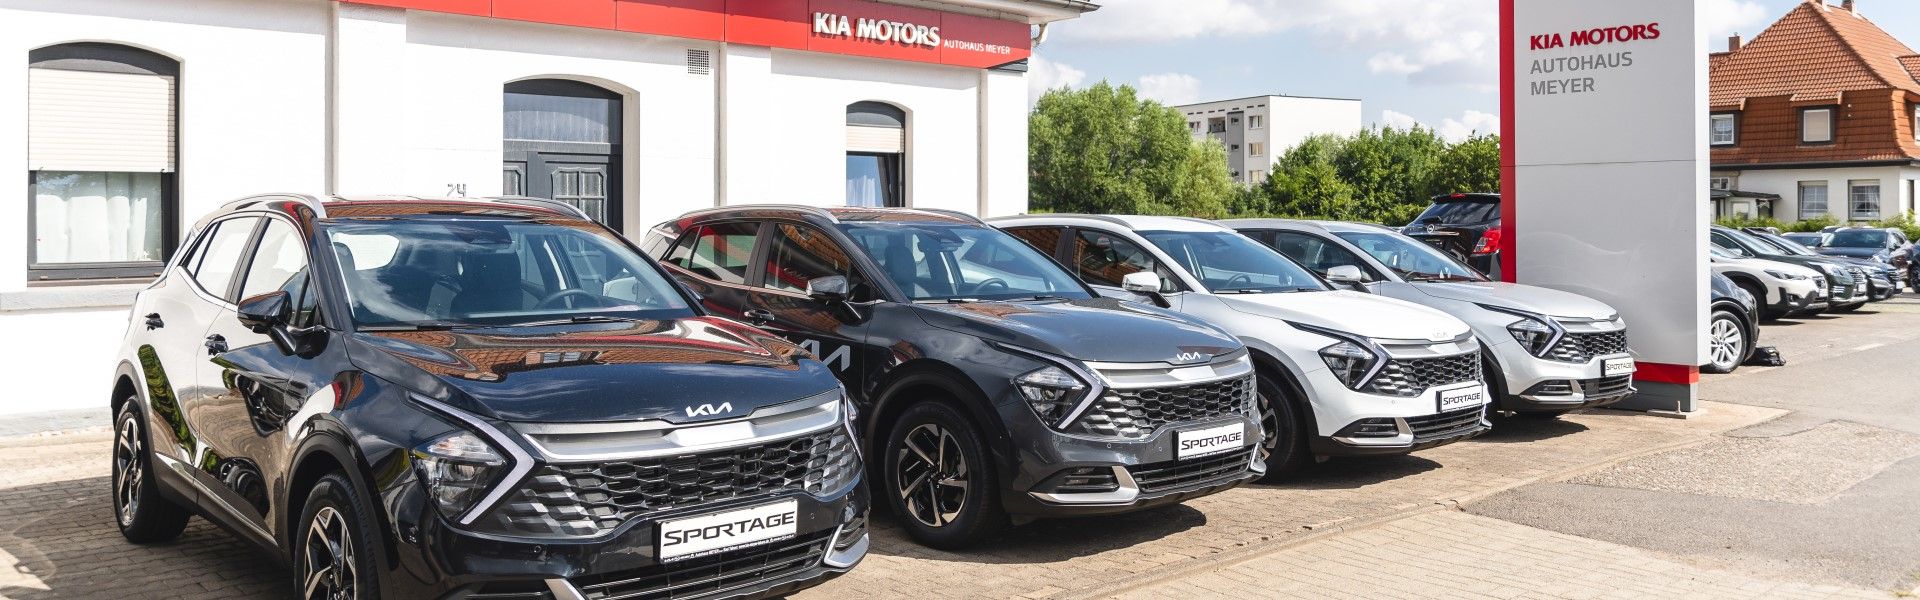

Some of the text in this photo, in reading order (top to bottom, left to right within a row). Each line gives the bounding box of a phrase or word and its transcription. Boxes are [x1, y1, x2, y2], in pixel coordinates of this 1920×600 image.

[813, 12, 941, 48] KIA MOTORS
[1530, 22, 1661, 51] KIA MOTORS
[943, 39, 1011, 55] AUTOHAUS MEYER
[1530, 51, 1633, 75] AUTOHAUS
[1530, 77, 1595, 96] MEYER
[1604, 362, 1632, 371] SPORTAGE
[1442, 392, 1481, 406] SPORTAGE
[685, 401, 733, 418] KIA
[1180, 431, 1242, 451] SPORTAGE
[662, 510, 796, 547] SPORTAGE
